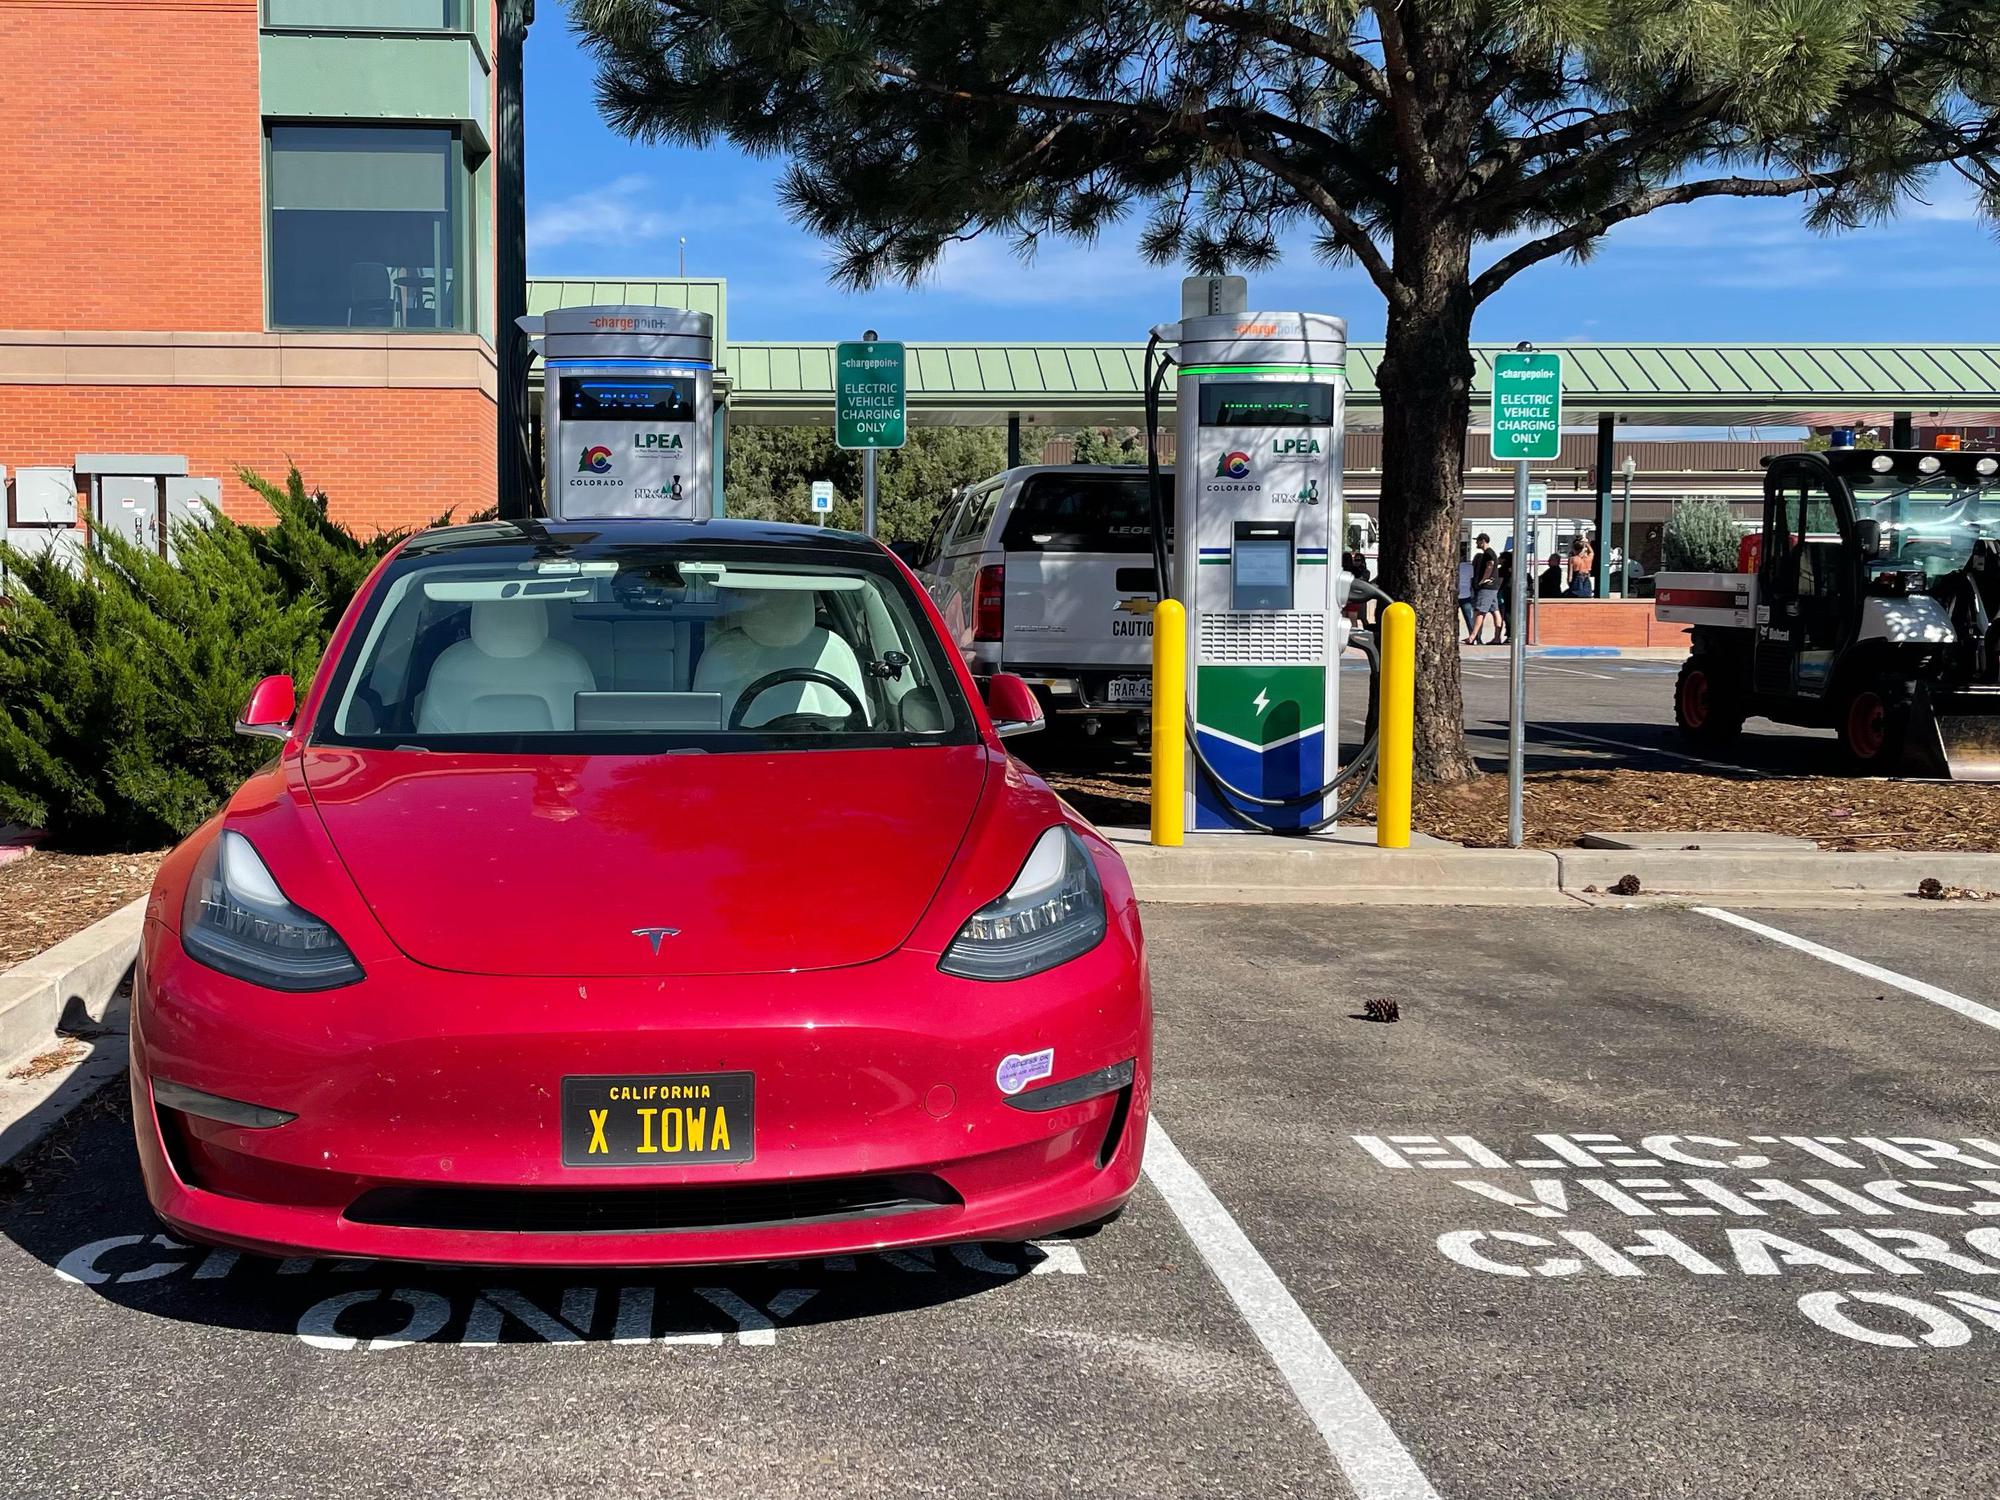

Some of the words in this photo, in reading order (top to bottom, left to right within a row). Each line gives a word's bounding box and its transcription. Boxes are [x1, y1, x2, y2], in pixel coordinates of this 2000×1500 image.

[1232, 322, 1304, 337] chargepoin
[845, 383, 897, 394] ELECTRIC
[848, 396, 894, 407] VEHICLE
[1501, 394, 1553, 405] ELECTRIC
[842, 409, 901, 420] CHARGING
[1504, 407, 1550, 418] VEHICLE
[857, 422, 886, 433] ONLY
[1497, 420, 1556, 431] CHARGING
[634, 433, 683, 449] LPEA
[1511, 433, 1541, 444] ONLY
[1273, 439, 1321, 454] LPEA
[570, 479, 624, 487] COLORADO
[1207, 484, 1261, 492] COLORADO
[609, 1085, 711, 1100] CALIFORNIA
[588, 1109, 609, 1154] X
[636, 1106, 731, 1153] IOWA
[296, 1286, 820, 1351] ONLY
